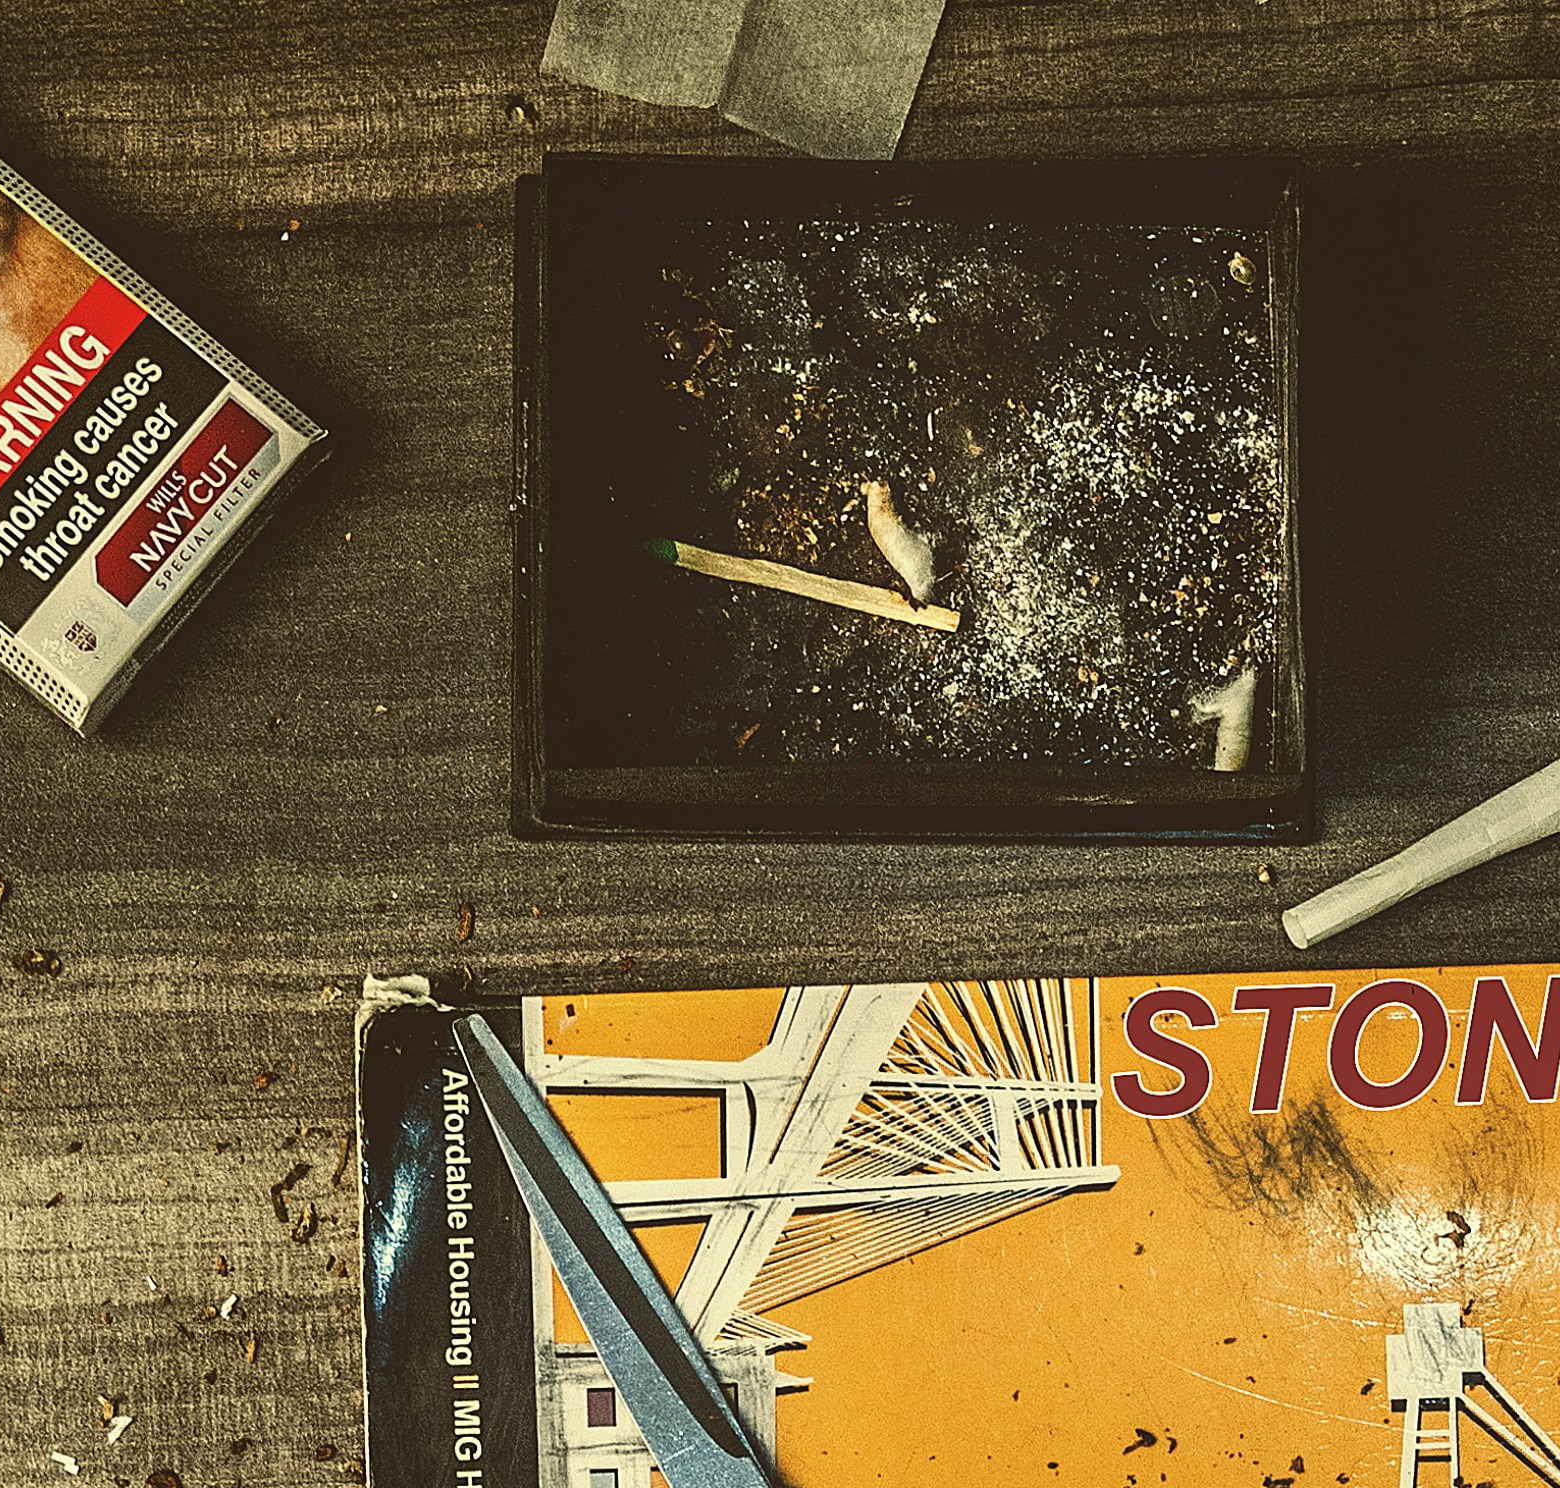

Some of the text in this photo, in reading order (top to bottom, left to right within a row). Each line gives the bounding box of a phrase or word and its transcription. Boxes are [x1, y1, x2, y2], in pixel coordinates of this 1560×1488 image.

[73, 357, 163, 455] causes
[19, 402, 178, 581] throat cancer
[130, 498, 195, 572] NAVY
[189, 445, 238, 505] CUT
[146, 469, 187, 514] WILLS
[155, 526, 213, 591] SPECIAL
[213, 467, 261, 523] FILTER
[442, 1068, 472, 1231] Affordable
[447, 1238, 476, 1366] Housing
[452, 1400, 484, 1462] MIG
